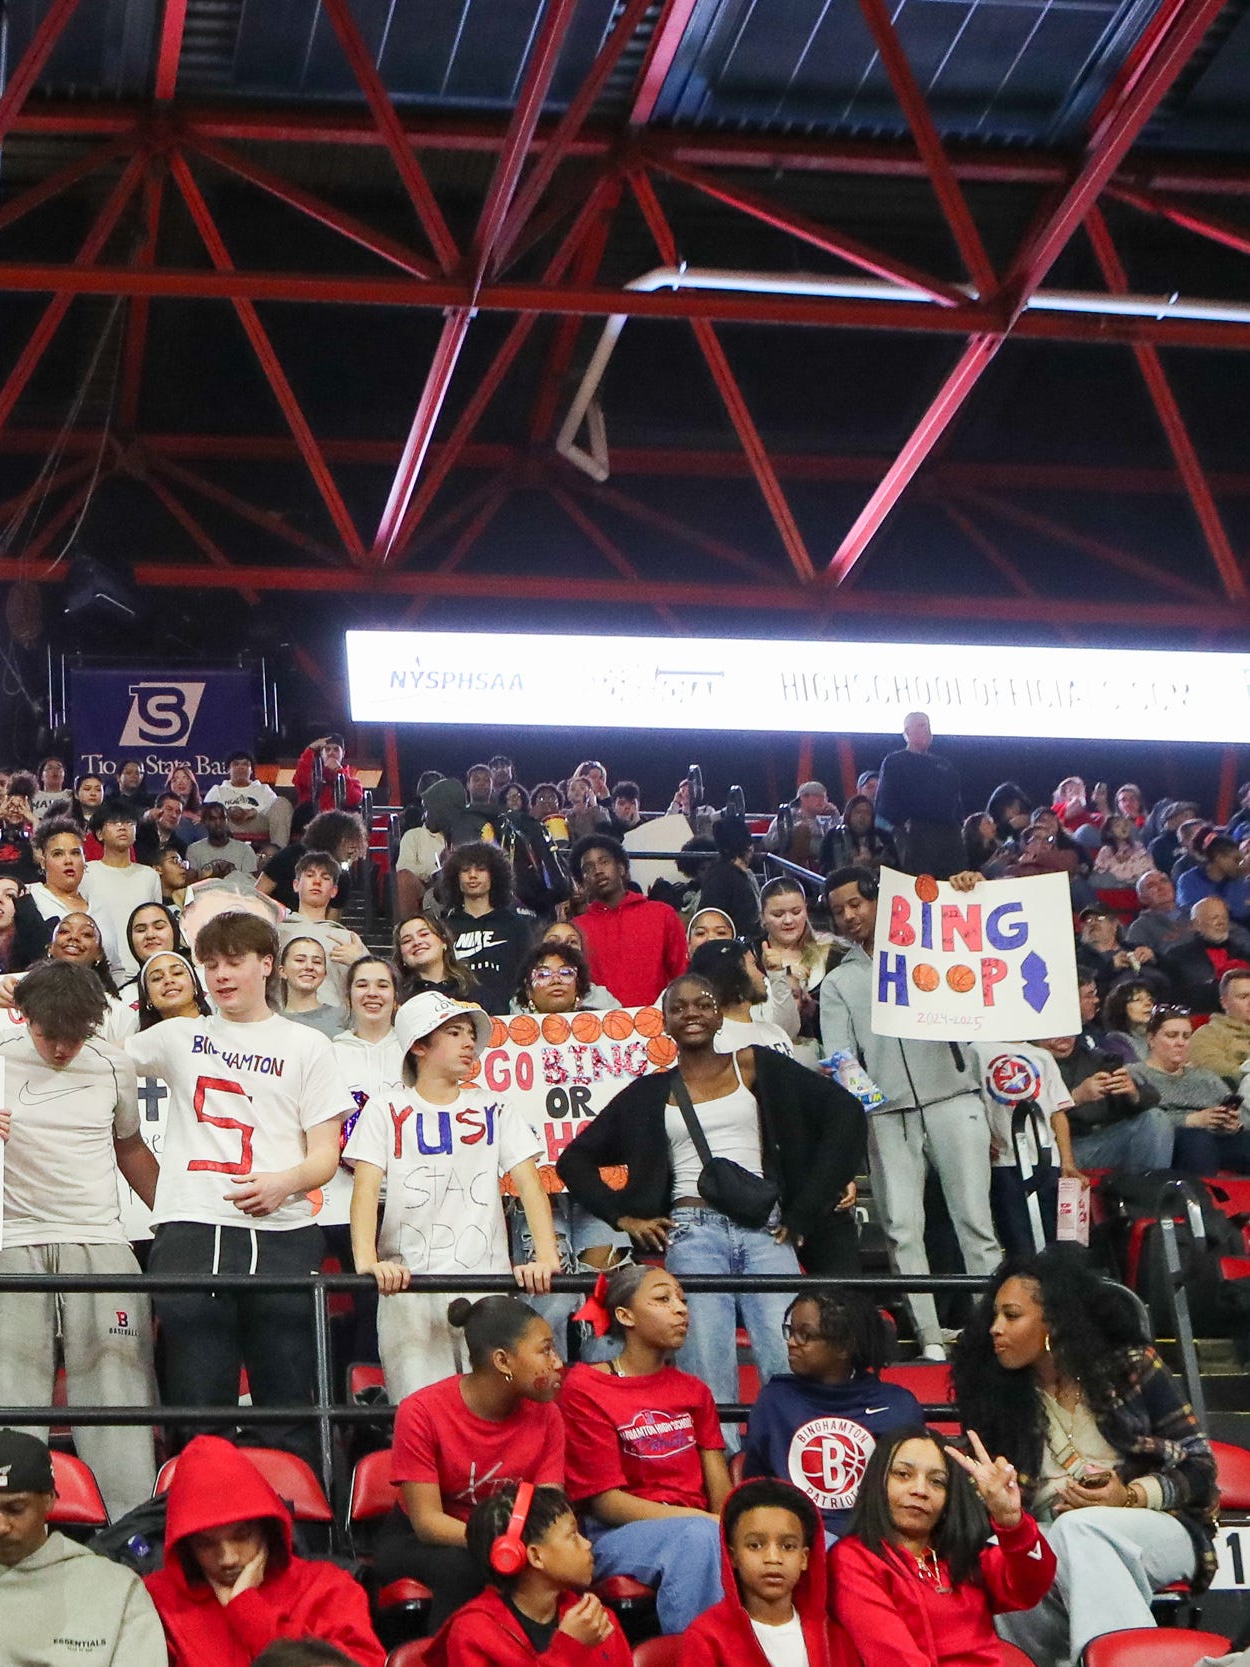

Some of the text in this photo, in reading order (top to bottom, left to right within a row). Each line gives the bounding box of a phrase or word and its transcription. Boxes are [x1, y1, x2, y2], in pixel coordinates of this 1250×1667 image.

[484, 1041, 649, 1093] GO BING
[545, 1085, 598, 1119] OR
[187, 1075, 255, 1176] 5
[115, 1310, 129, 1328] B
[796, 1420, 870, 1445] BINGHAMTON
[821, 1438, 846, 1489] B
